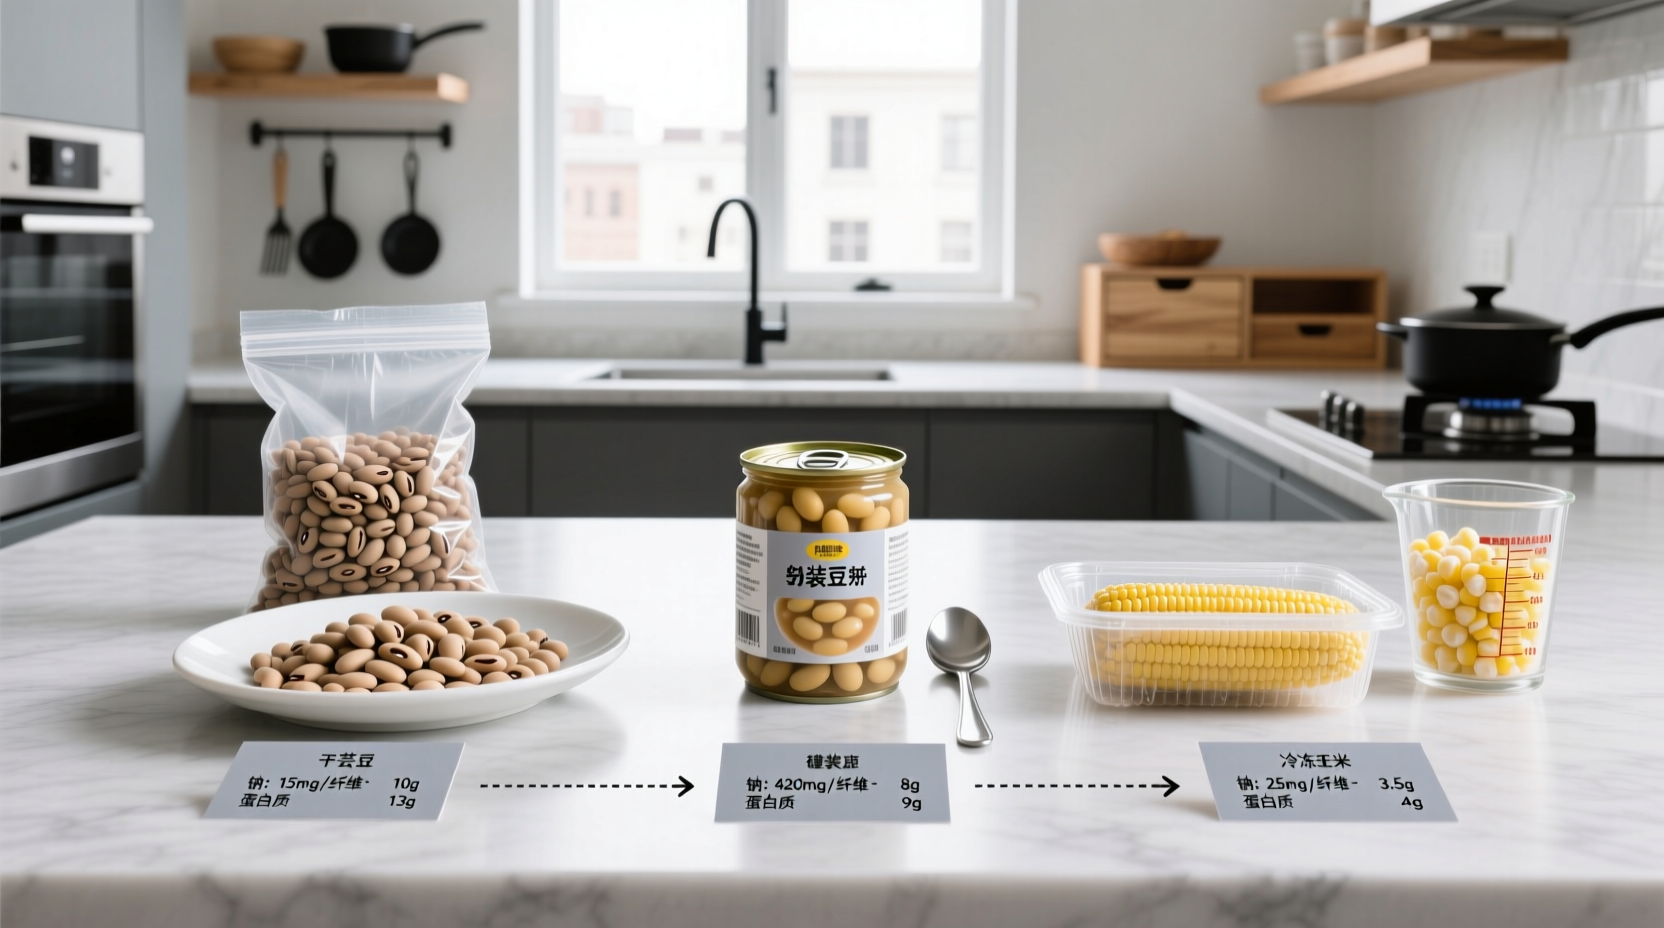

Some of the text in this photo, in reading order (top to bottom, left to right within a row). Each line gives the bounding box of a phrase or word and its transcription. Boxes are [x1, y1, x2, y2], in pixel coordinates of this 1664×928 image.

[394, 778, 420, 793] 10g
[900, 778, 920, 794] 8g
[1378, 777, 1415, 793] 3.5g
[238, 794, 416, 810] 蛋白质 13g
[745, 795, 922, 812] 蛋白质 9g
[1242, 794, 1424, 811] 蛋白质 4g
